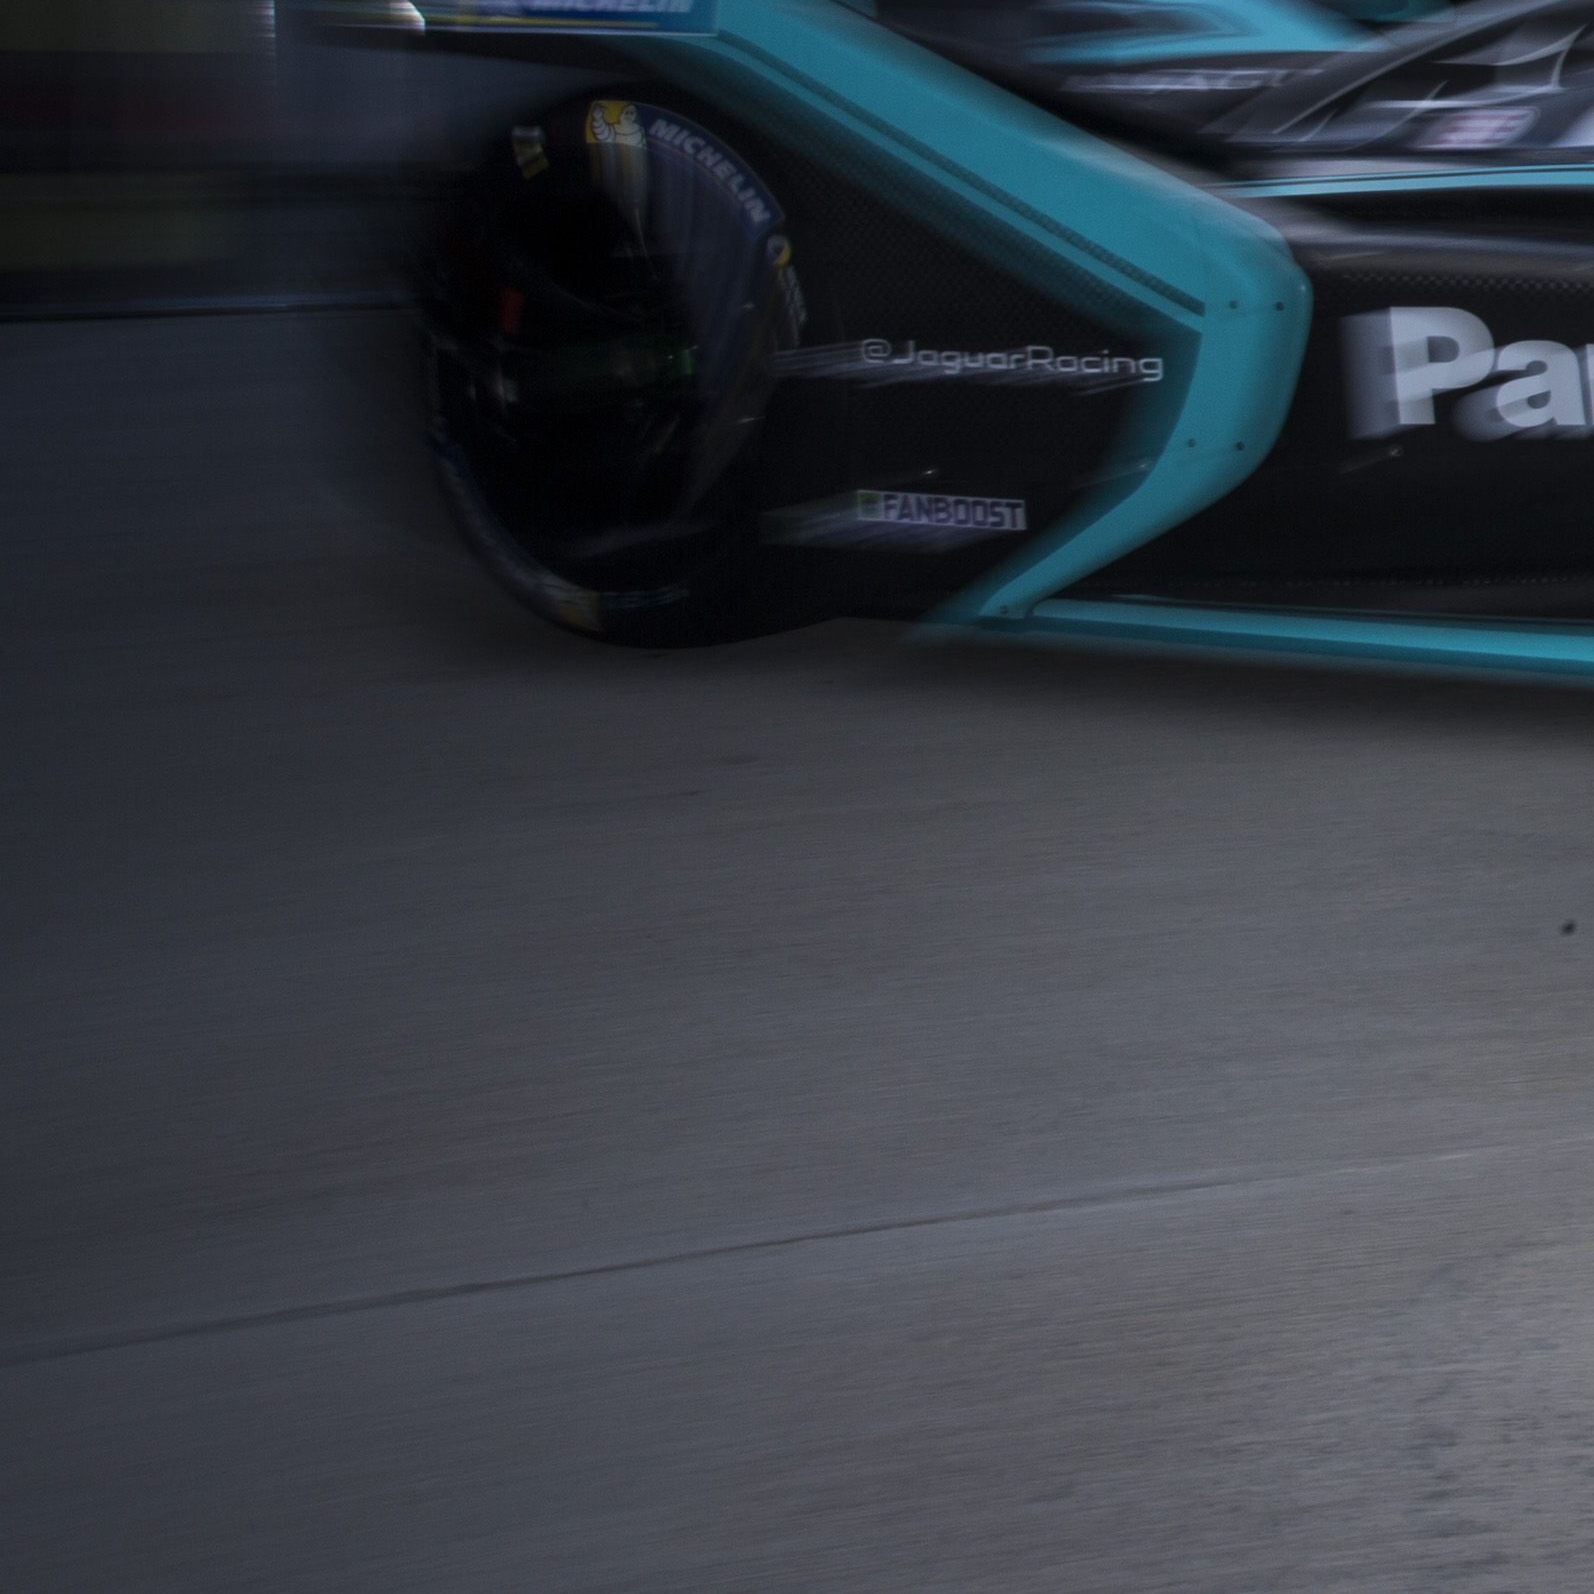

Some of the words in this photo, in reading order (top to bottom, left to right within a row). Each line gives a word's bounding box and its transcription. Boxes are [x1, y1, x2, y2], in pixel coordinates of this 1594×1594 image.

[649, 118, 772, 225] MICHELIN
[861, 338, 1164, 382] @JaguarRacing
[884, 494, 1024, 529] FANBOOST
